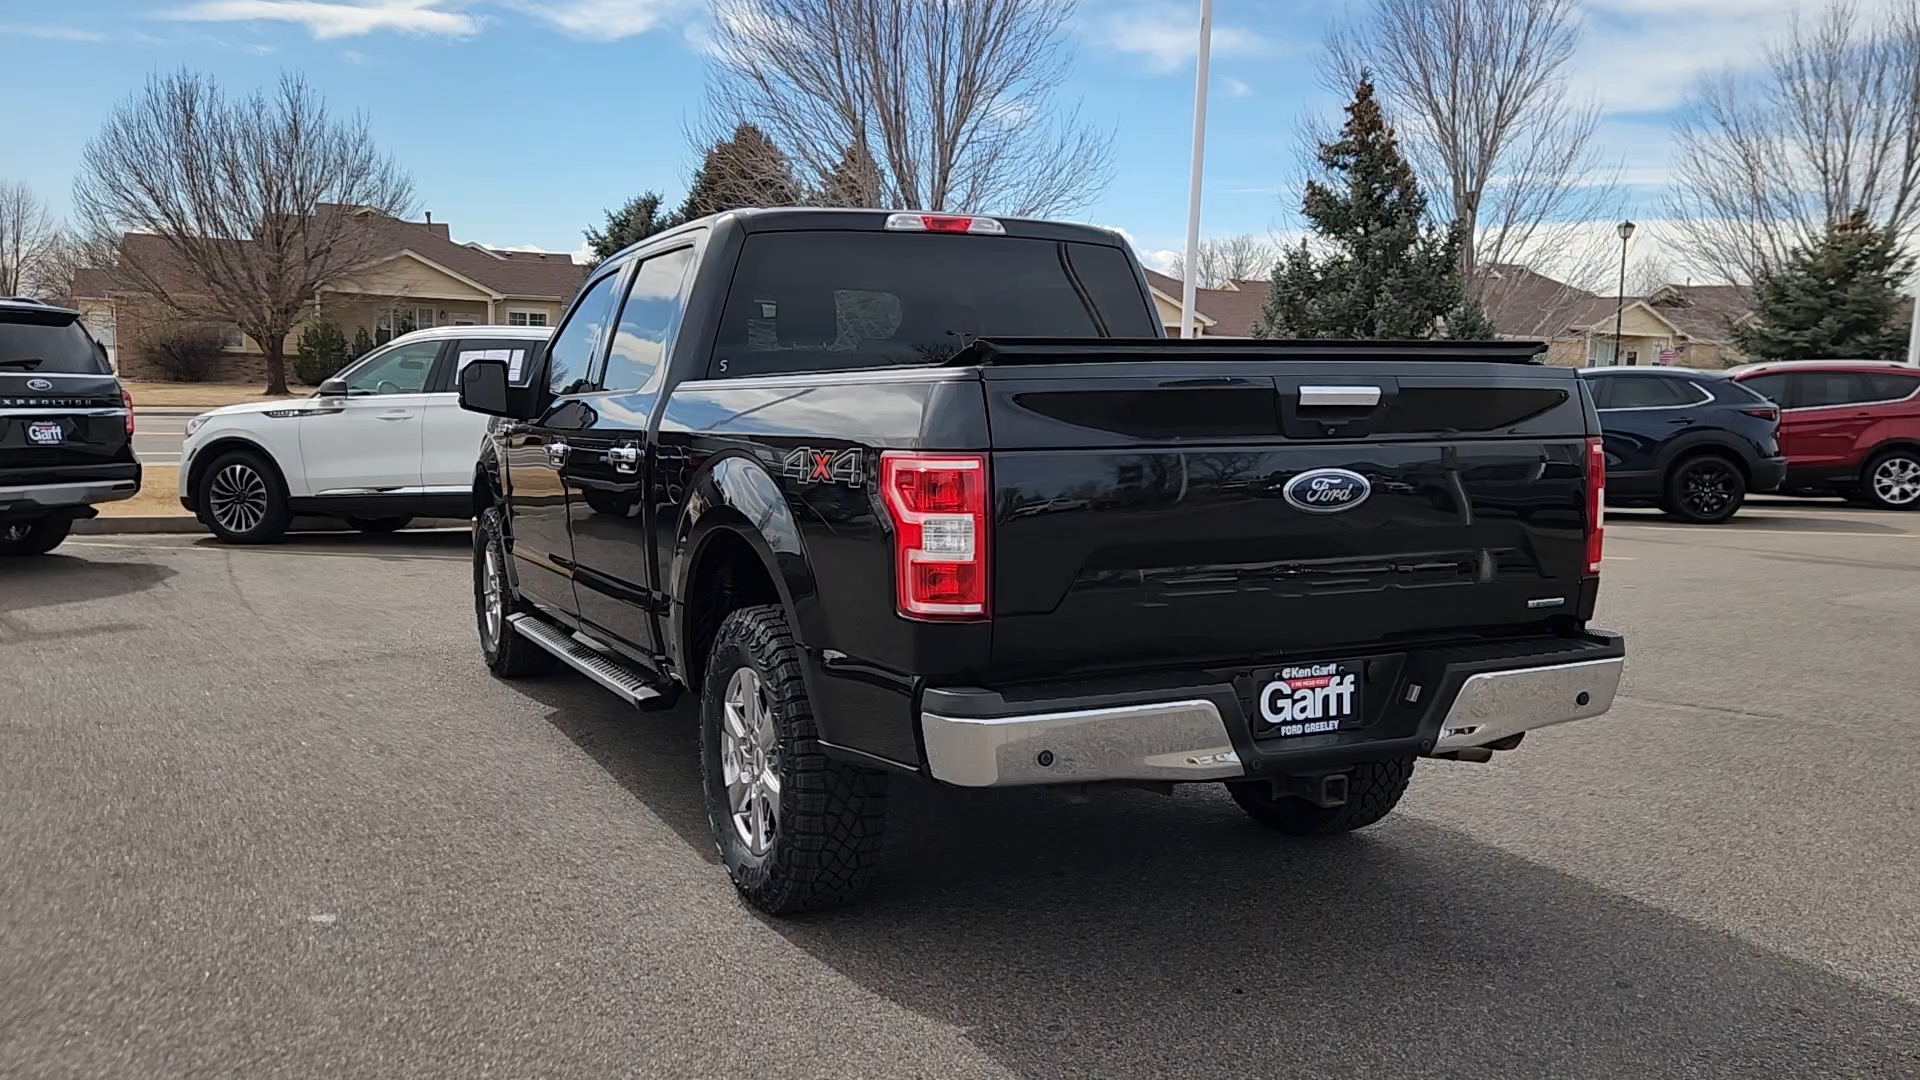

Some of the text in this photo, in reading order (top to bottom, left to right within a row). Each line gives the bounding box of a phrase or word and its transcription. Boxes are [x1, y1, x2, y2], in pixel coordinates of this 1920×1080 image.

[28, 425, 63, 441] Garff
[1306, 478, 1354, 502] Ford
[1291, 667, 1311, 678] Ken
[1312, 663, 1337, 676] Garff
[1260, 674, 1355, 723] Garff
[1281, 720, 1340, 737] FORD GREELEY
